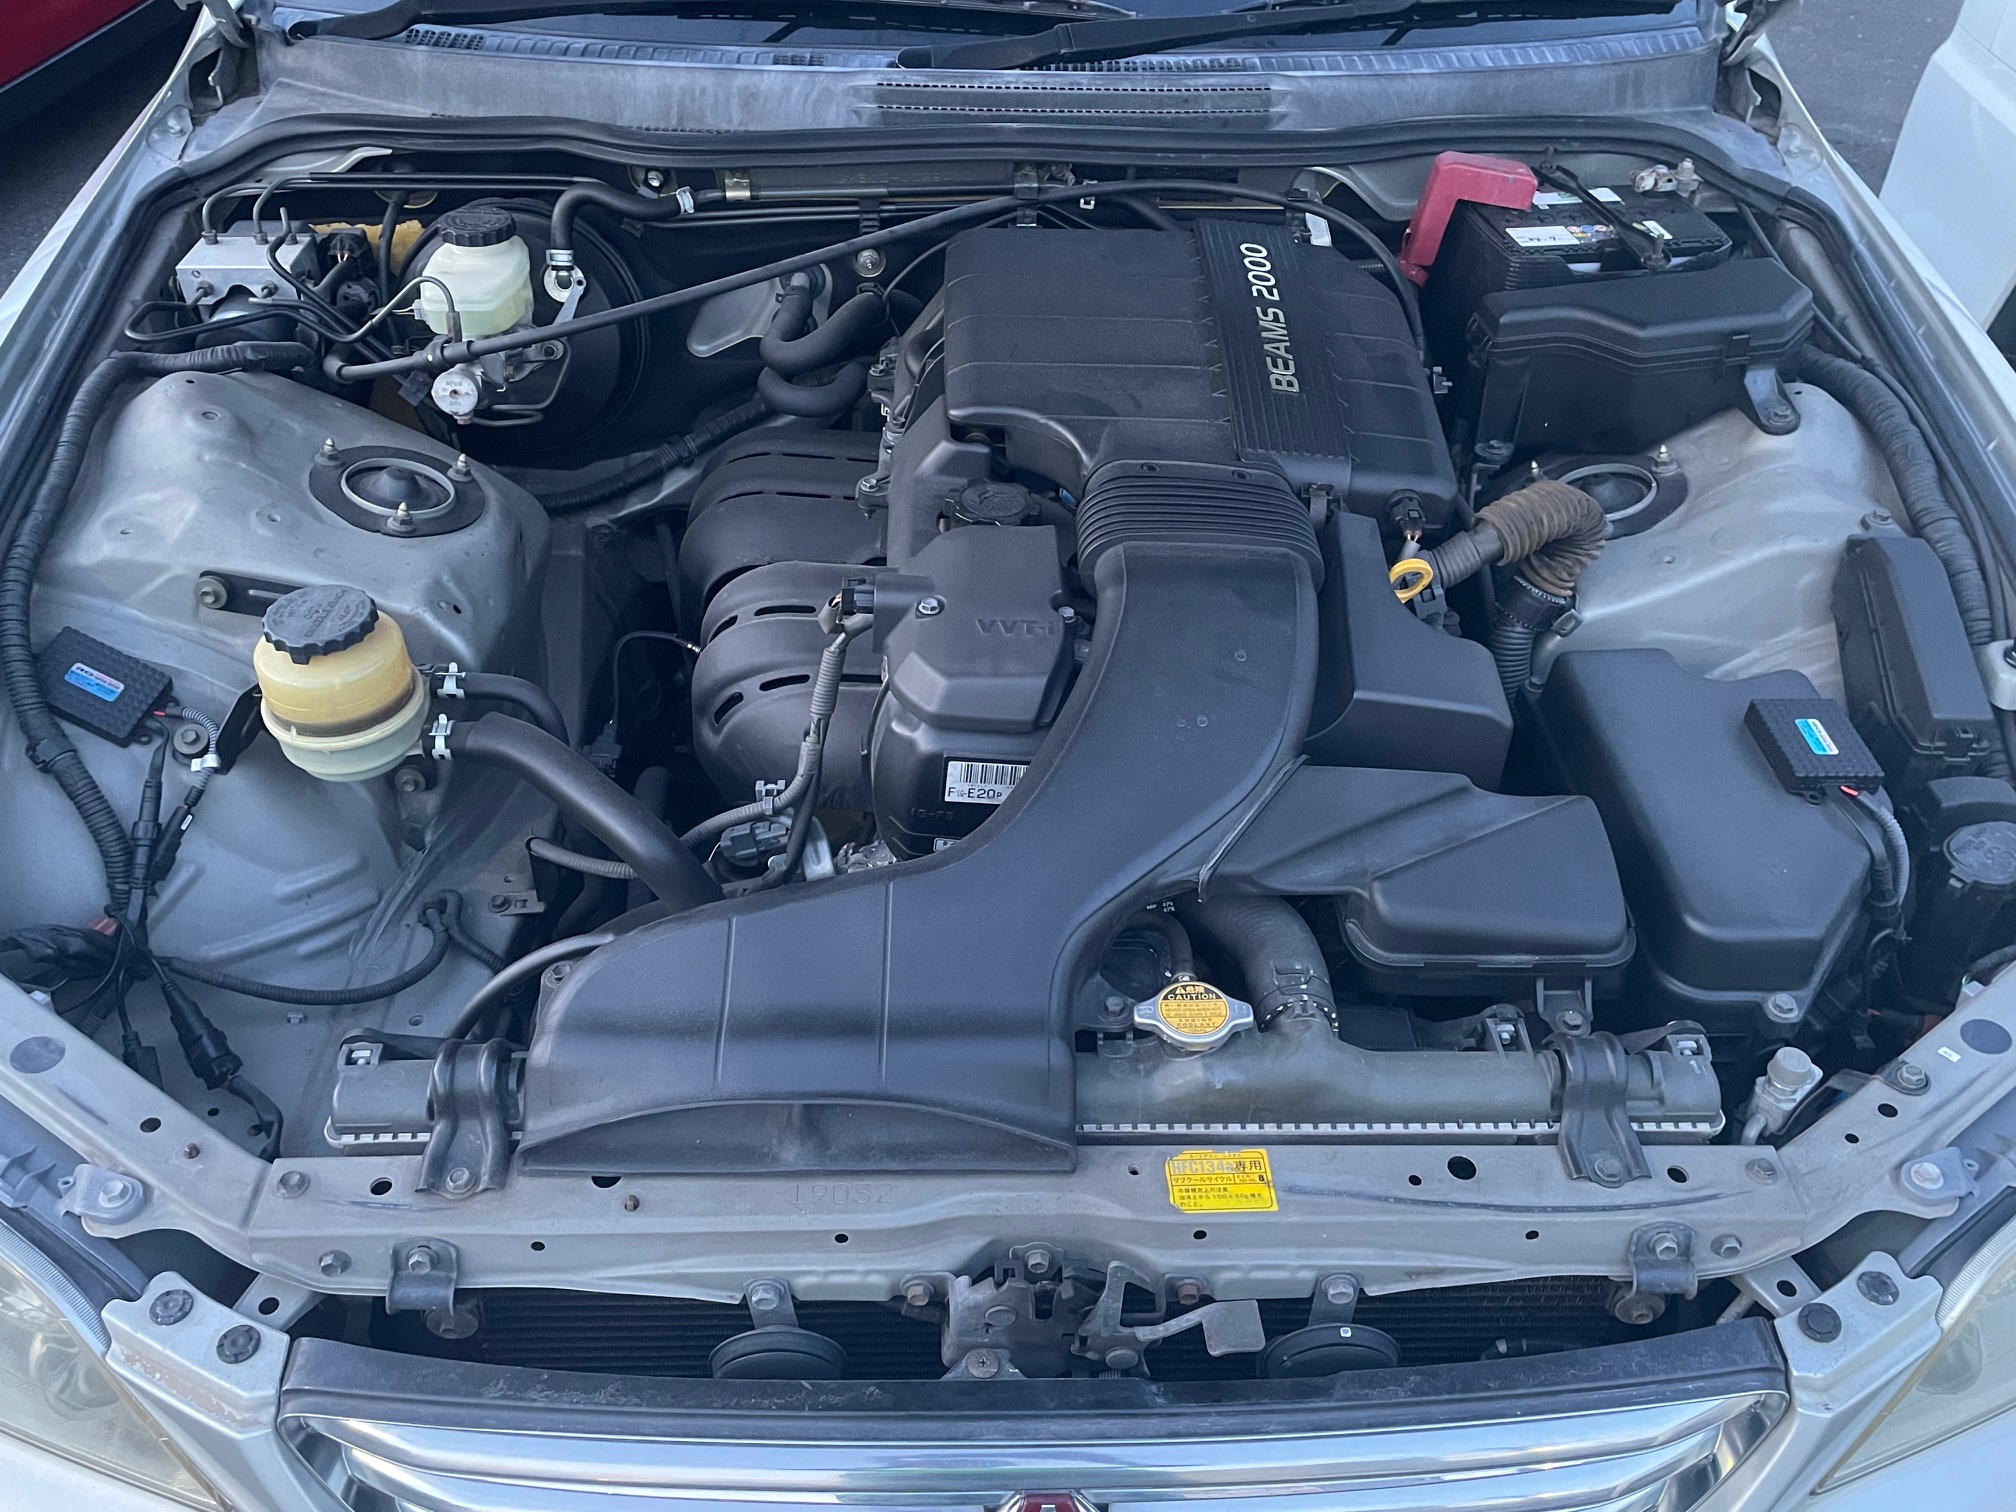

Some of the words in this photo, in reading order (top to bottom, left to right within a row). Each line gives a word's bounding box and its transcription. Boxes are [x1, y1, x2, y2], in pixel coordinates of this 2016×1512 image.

[1239, 243, 1280, 301] 2000
[1256, 306, 1299, 392] BEAMS
[975, 619, 1054, 636] VVT-i
[947, 787, 956, 797] F
